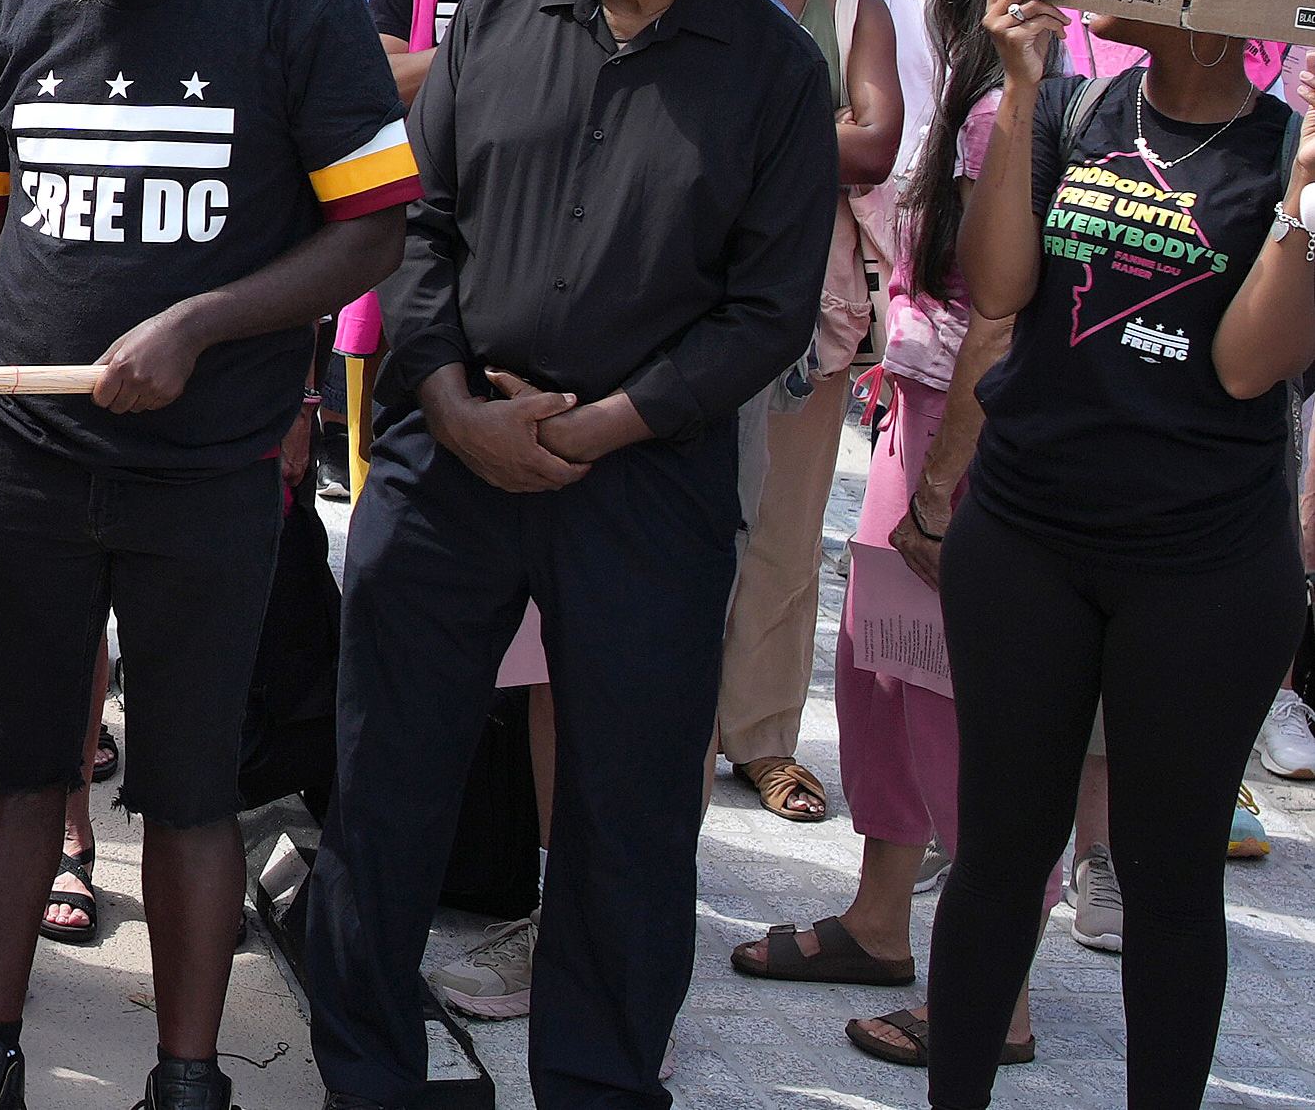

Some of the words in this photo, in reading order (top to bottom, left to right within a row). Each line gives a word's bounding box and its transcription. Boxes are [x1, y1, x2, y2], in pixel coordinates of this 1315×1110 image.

[20, 170, 126, 242] FREE
[142, 178, 229, 243] DC
[1057, 187, 1115, 212] FREE
[1114, 198, 1196, 235] UNTIL
[1046, 208, 1229, 273] EVERYBODY'S
[1111, 262, 1153, 280] HAMER
[1156, 261, 1182, 277] LOU
[1121, 334, 1161, 356] FREE
[1163, 346, 1189, 362] DC
